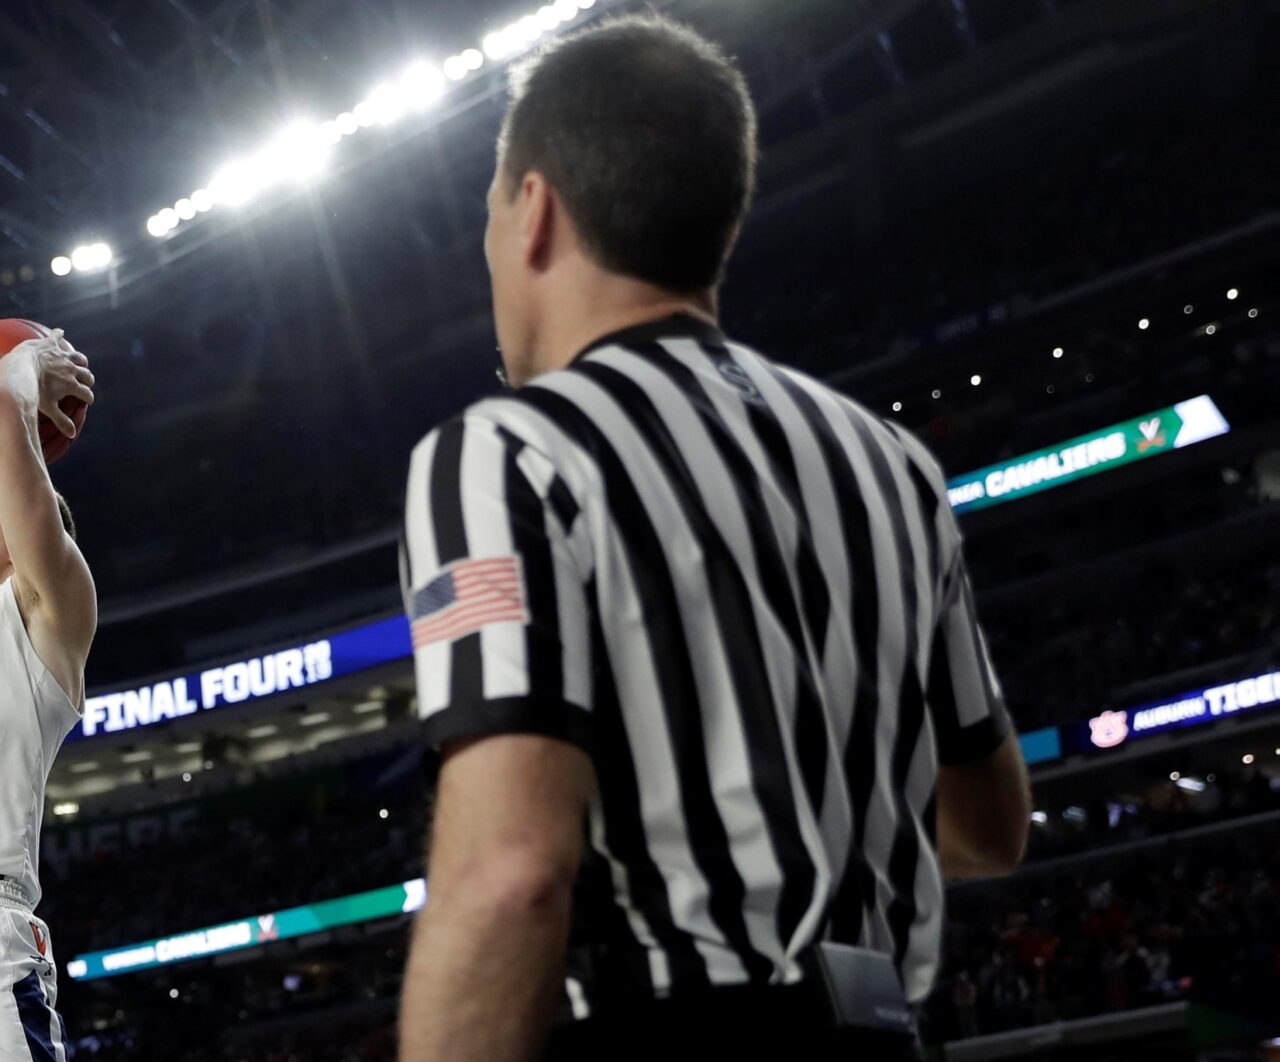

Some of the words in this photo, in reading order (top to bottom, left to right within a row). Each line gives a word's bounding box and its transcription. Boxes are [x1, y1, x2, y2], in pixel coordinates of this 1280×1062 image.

[985, 432, 1126, 497] CAVALIERS
[82, 677, 197, 736] FINAL
[200, 647, 305, 710] FOUR
[1133, 696, 1206, 731] AUBURN
